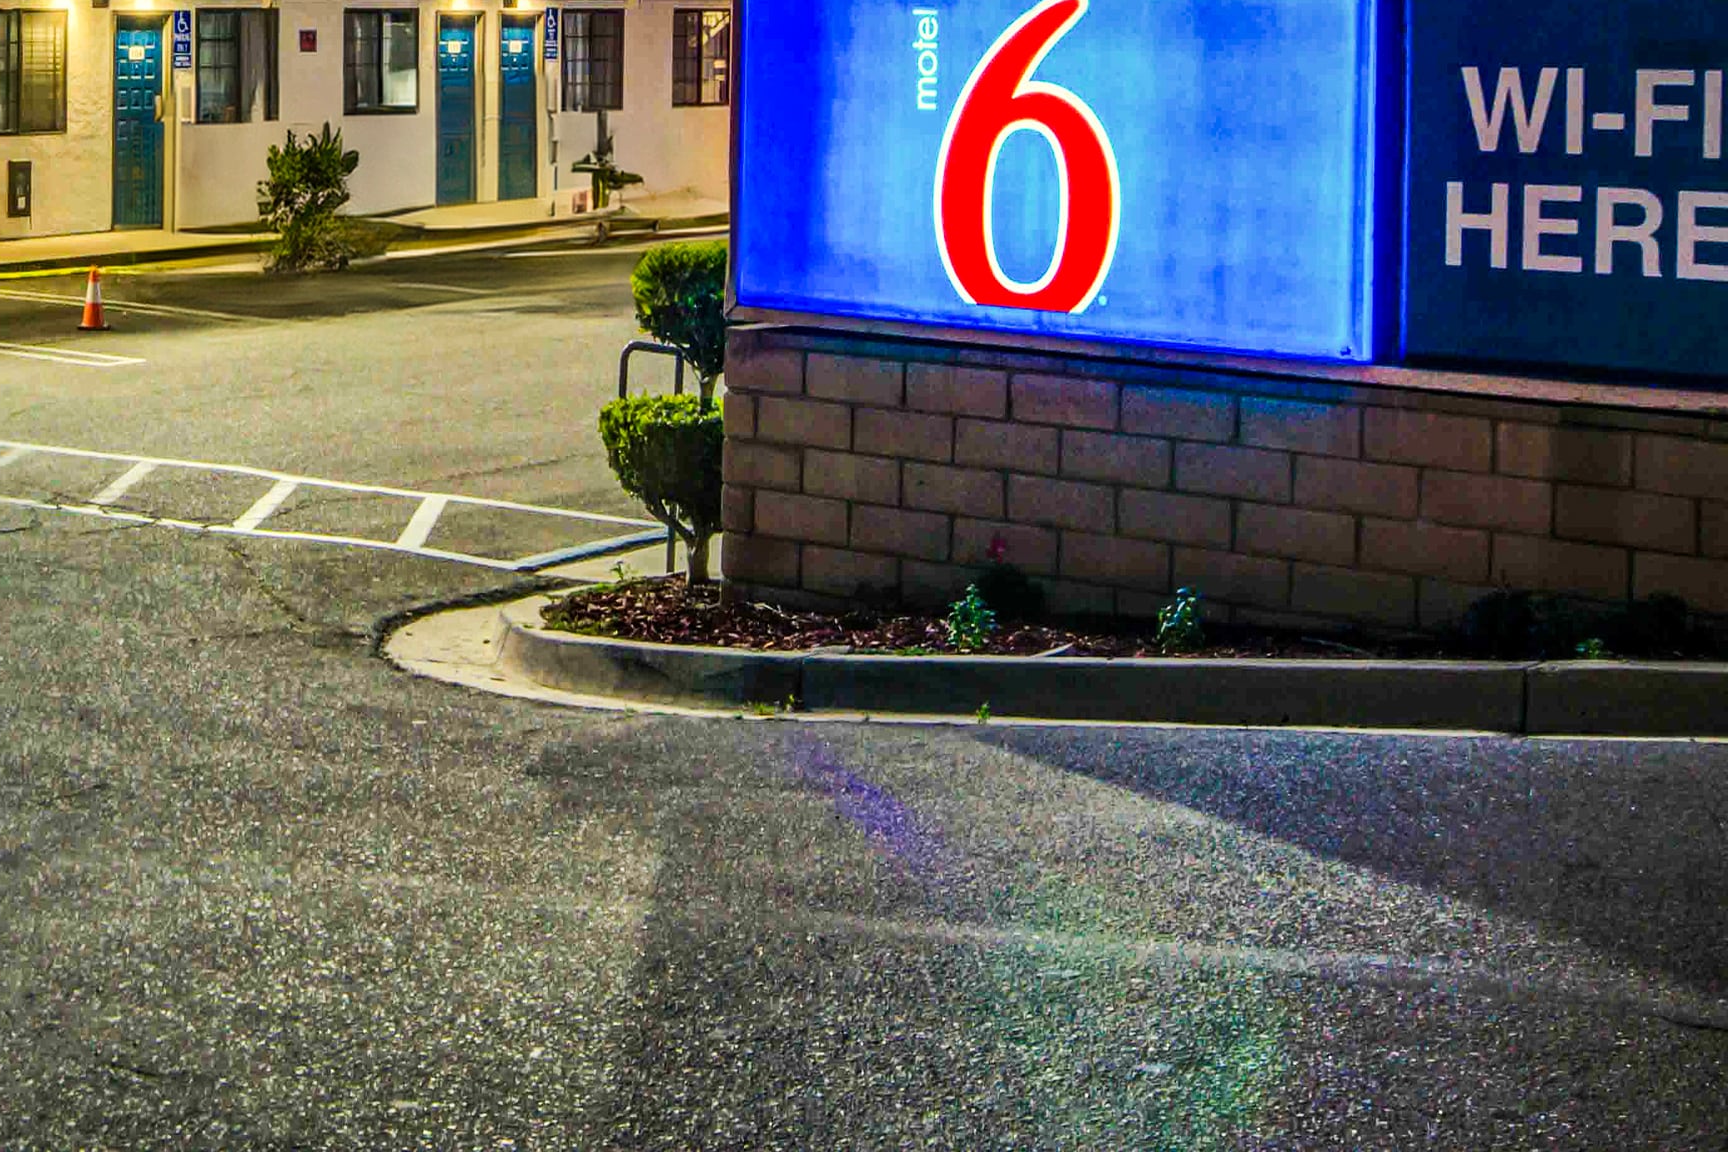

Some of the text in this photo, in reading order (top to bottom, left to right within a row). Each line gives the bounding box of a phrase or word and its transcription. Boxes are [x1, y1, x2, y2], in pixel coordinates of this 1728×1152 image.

[911, 6, 940, 111] motel
[1461, 66, 1722, 159] WI-FI
[1445, 181, 1728, 281] HERE
